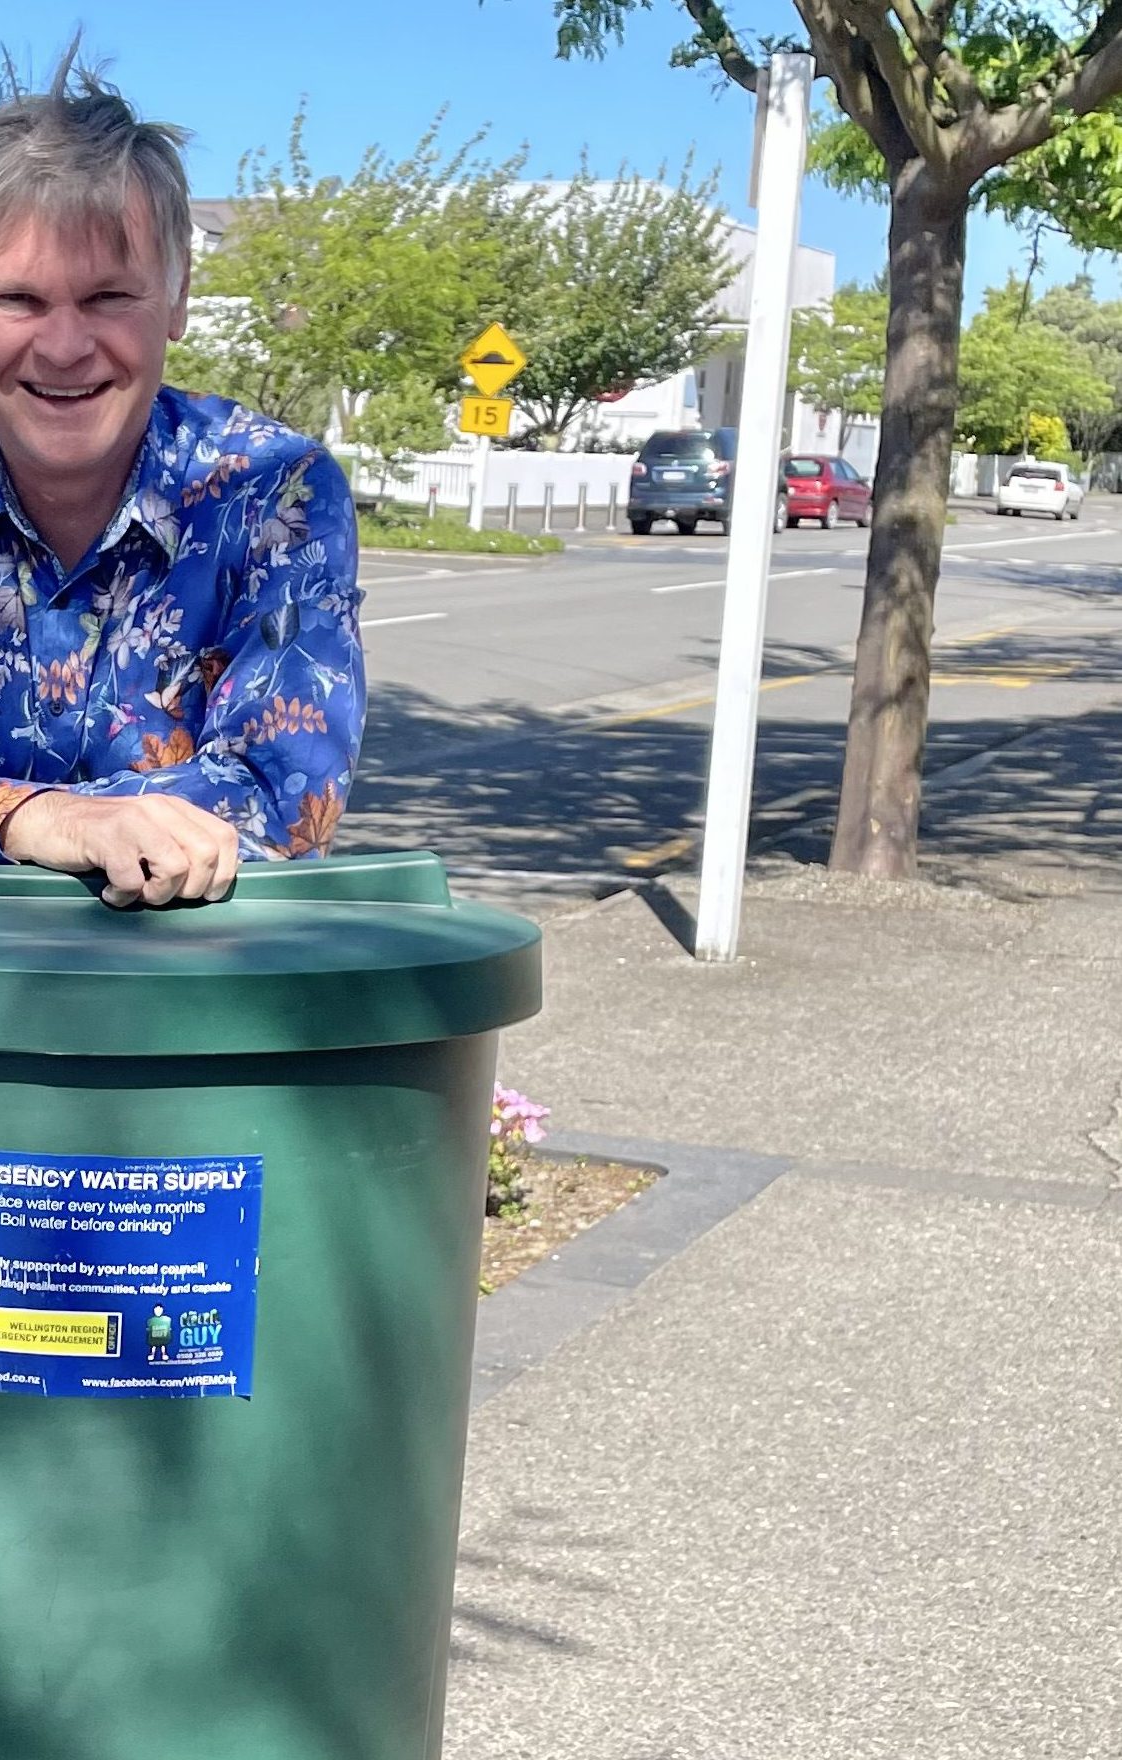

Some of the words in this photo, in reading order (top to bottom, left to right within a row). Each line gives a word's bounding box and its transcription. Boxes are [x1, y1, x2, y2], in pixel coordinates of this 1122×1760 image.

[473, 406, 498, 426] 15
[80, 1170, 159, 1190] WATER
[163, 1170, 246, 1191] SUPPLY
[26, 1197, 65, 1211] water
[67, 1200, 105, 1216] every
[108, 1200, 152, 1214] twelve
[155, 1200, 206, 1214] months
[0, 1212, 26, 1227] Boil
[29, 1215, 68, 1229] water
[71, 1217, 115, 1231] before
[118, 1219, 172, 1235] drinking
[12, 1257, 76, 1273] supported
[79, 1262, 94, 1276] by
[97, 1263, 128, 1276] your
[128, 1262, 158, 1275] local
[160, 1261, 206, 1275] council
[171, 1283, 191, 1294] and
[192, 1282, 232, 1295] capable
[9, 1321, 68, 1334] WELLINGTON
[70, 1325, 105, 1335] REGION
[179, 1324, 223, 1348] GUY
[40, 1334, 105, 1345] MANAGEMENT
